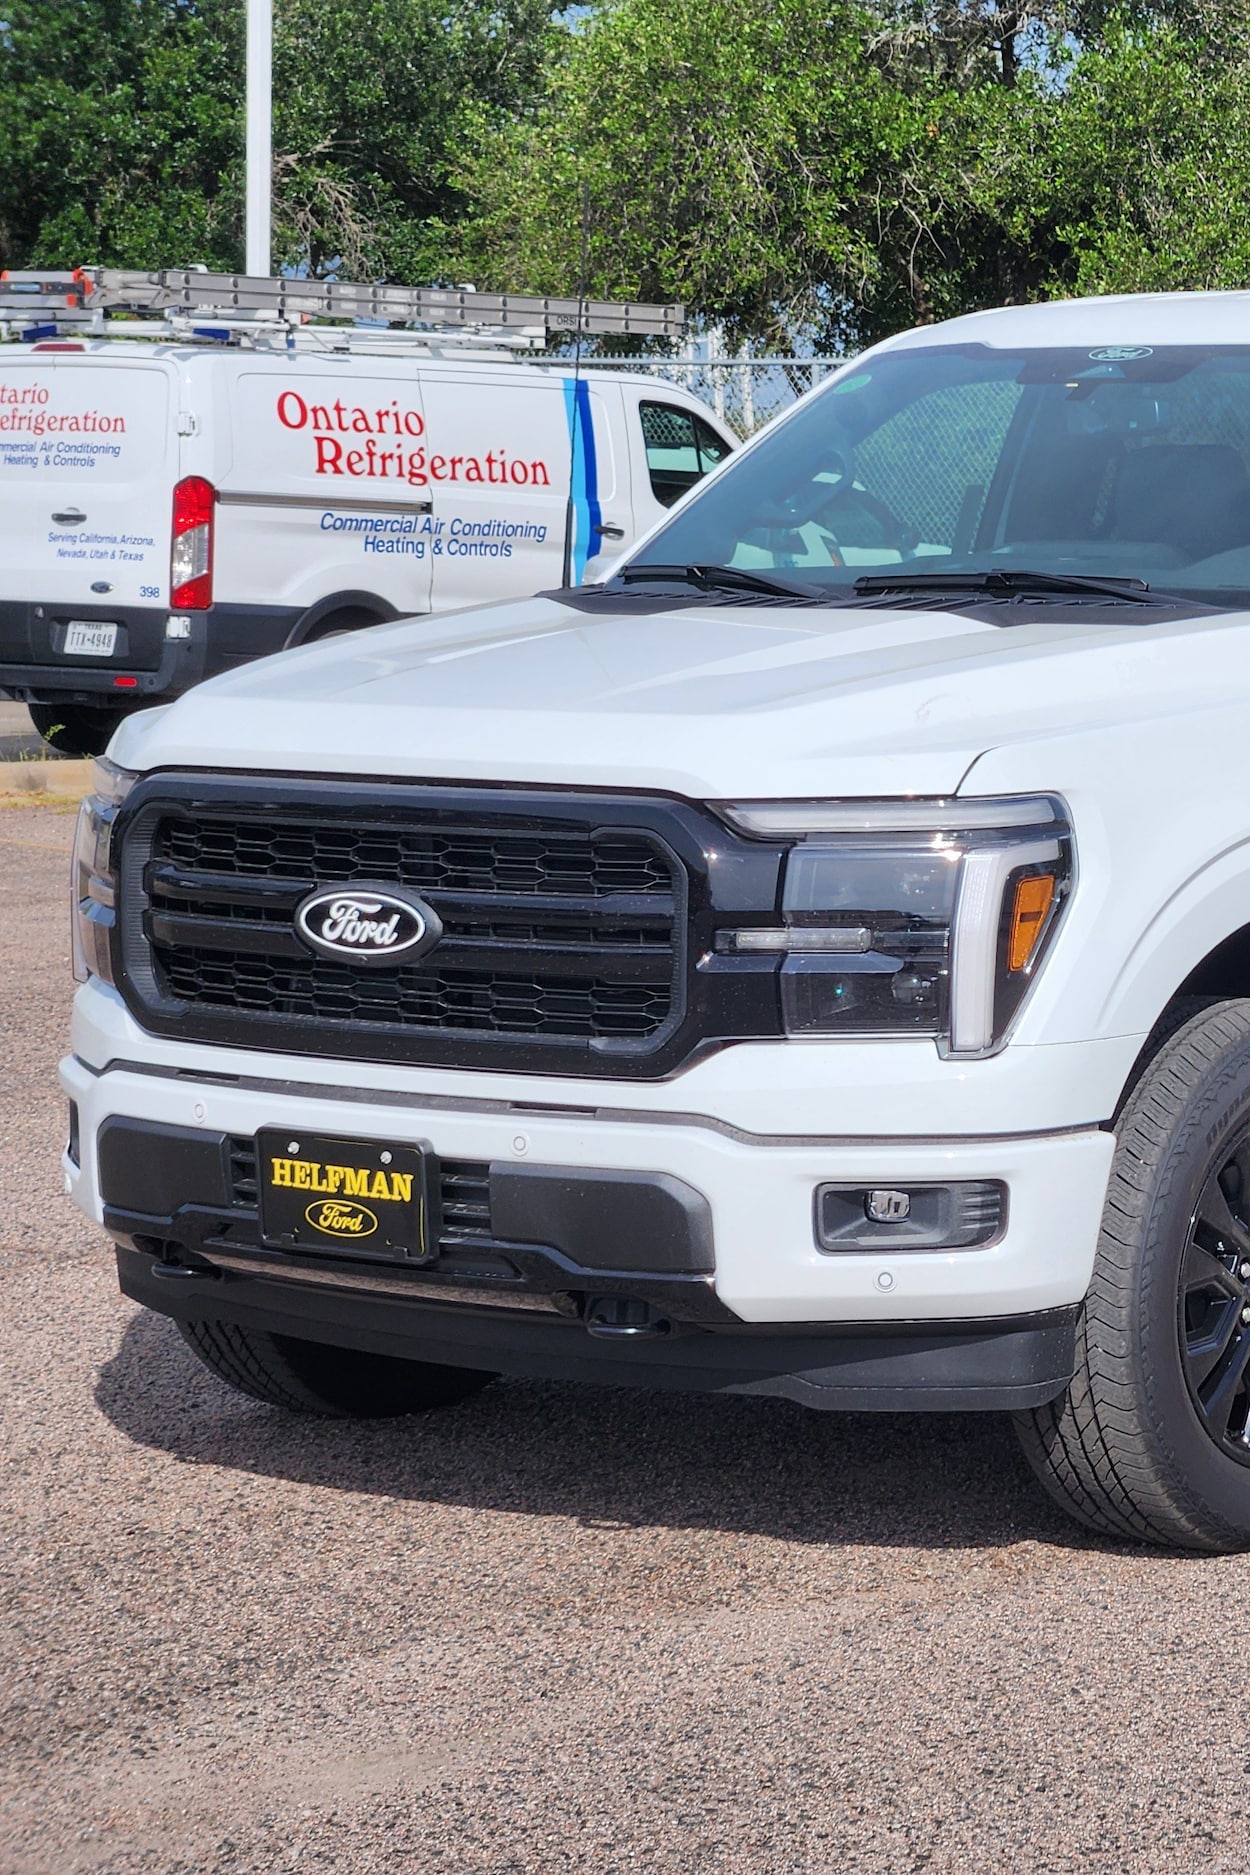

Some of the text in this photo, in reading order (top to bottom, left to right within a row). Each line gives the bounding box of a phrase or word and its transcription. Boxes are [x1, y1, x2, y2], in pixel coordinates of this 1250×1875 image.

[0, 407, 126, 436] efrigeration
[277, 391, 424, 436] Ontario
[4, 454, 95, 469] Heating & Controls
[40, 441, 54, 453] Air
[57, 442, 121, 458] Conditioning
[313, 436, 551, 486] Refrigeration
[48, 532, 156, 546] Serving California, Arizona,
[320, 513, 547, 543] Commercial Air Conditioning
[57, 549, 144, 561] Nevada, Utah & Texas
[364, 536, 513, 559] Heating & Controls
[140, 586, 160, 598] 398
[322, 899, 400, 943] Ford
[271, 1157, 414, 1203] HELFMAN
[317, 1203, 364, 1233] Ford
